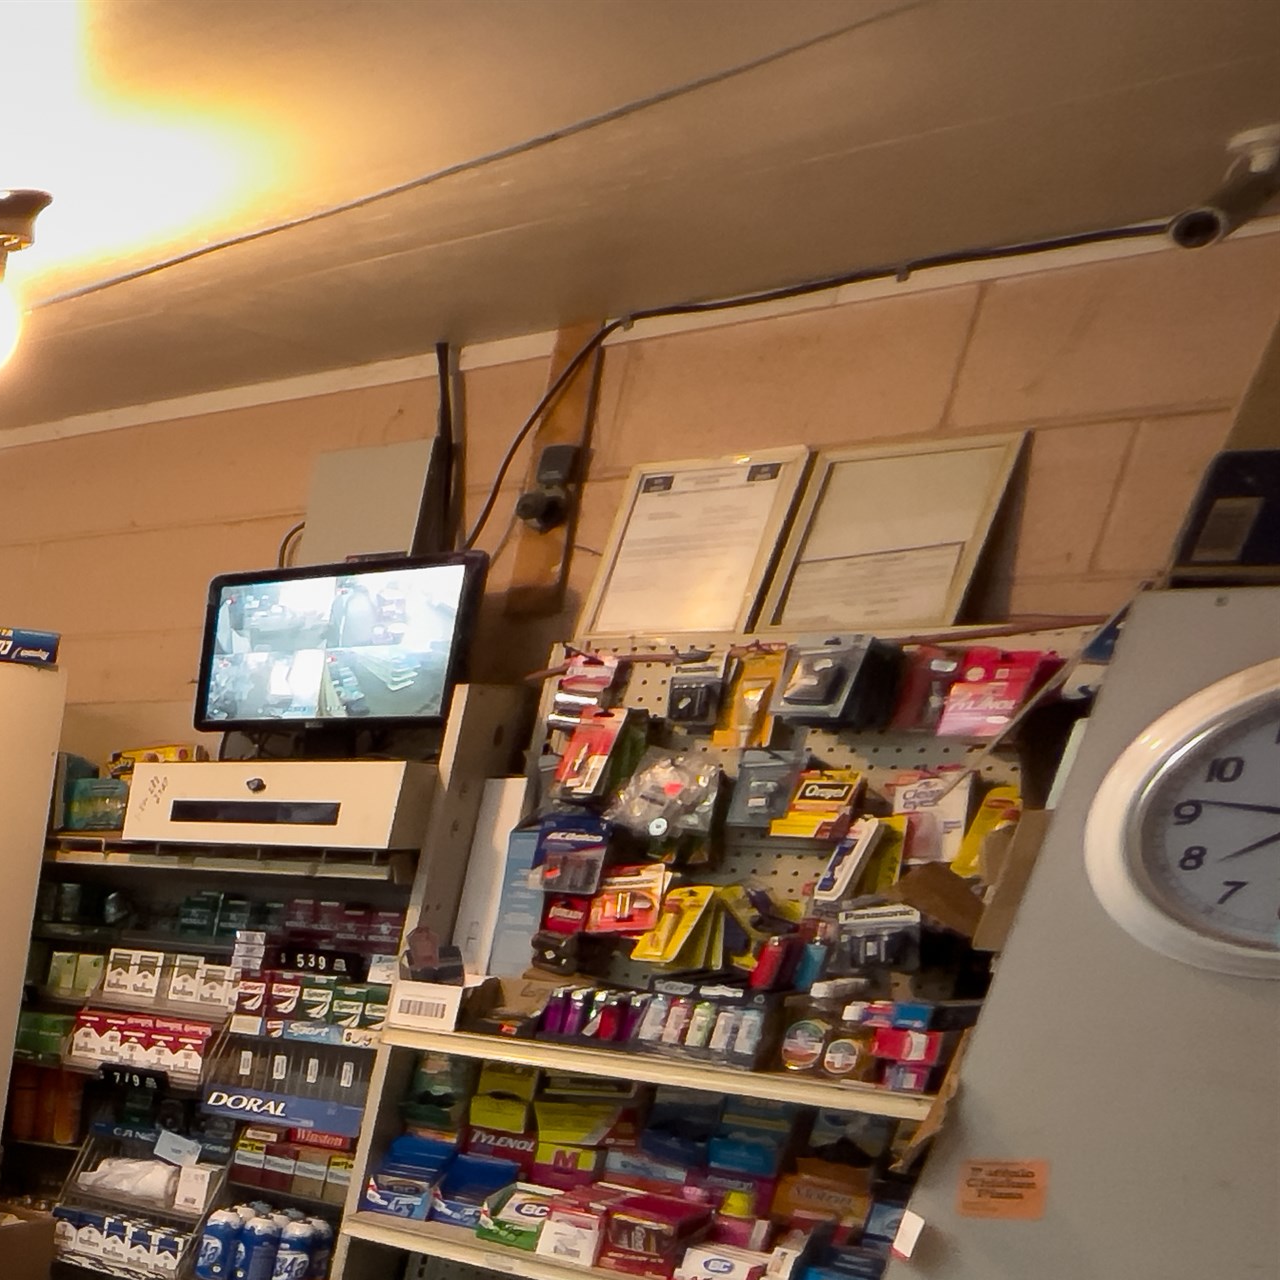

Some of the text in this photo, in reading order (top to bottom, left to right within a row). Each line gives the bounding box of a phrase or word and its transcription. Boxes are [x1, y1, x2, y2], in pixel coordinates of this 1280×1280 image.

[1206, 756, 1246, 783] 10
[1173, 801, 1204, 826] 9
[1180, 845, 1209, 871] 8
[1217, 880, 1250, 906] 7
[844, 907, 915, 920] Panasonic
[296, 953, 326, 969] 539
[241, 981, 263, 992] Sport
[273, 984, 299, 995] Sport
[304, 989, 330, 1000] Sport
[288, 1022, 330, 1037] Sport
[206, 1091, 287, 1117] DORAL
[296, 1128, 343, 1147] Winston
[469, 1129, 536, 1152] TYLENOL
